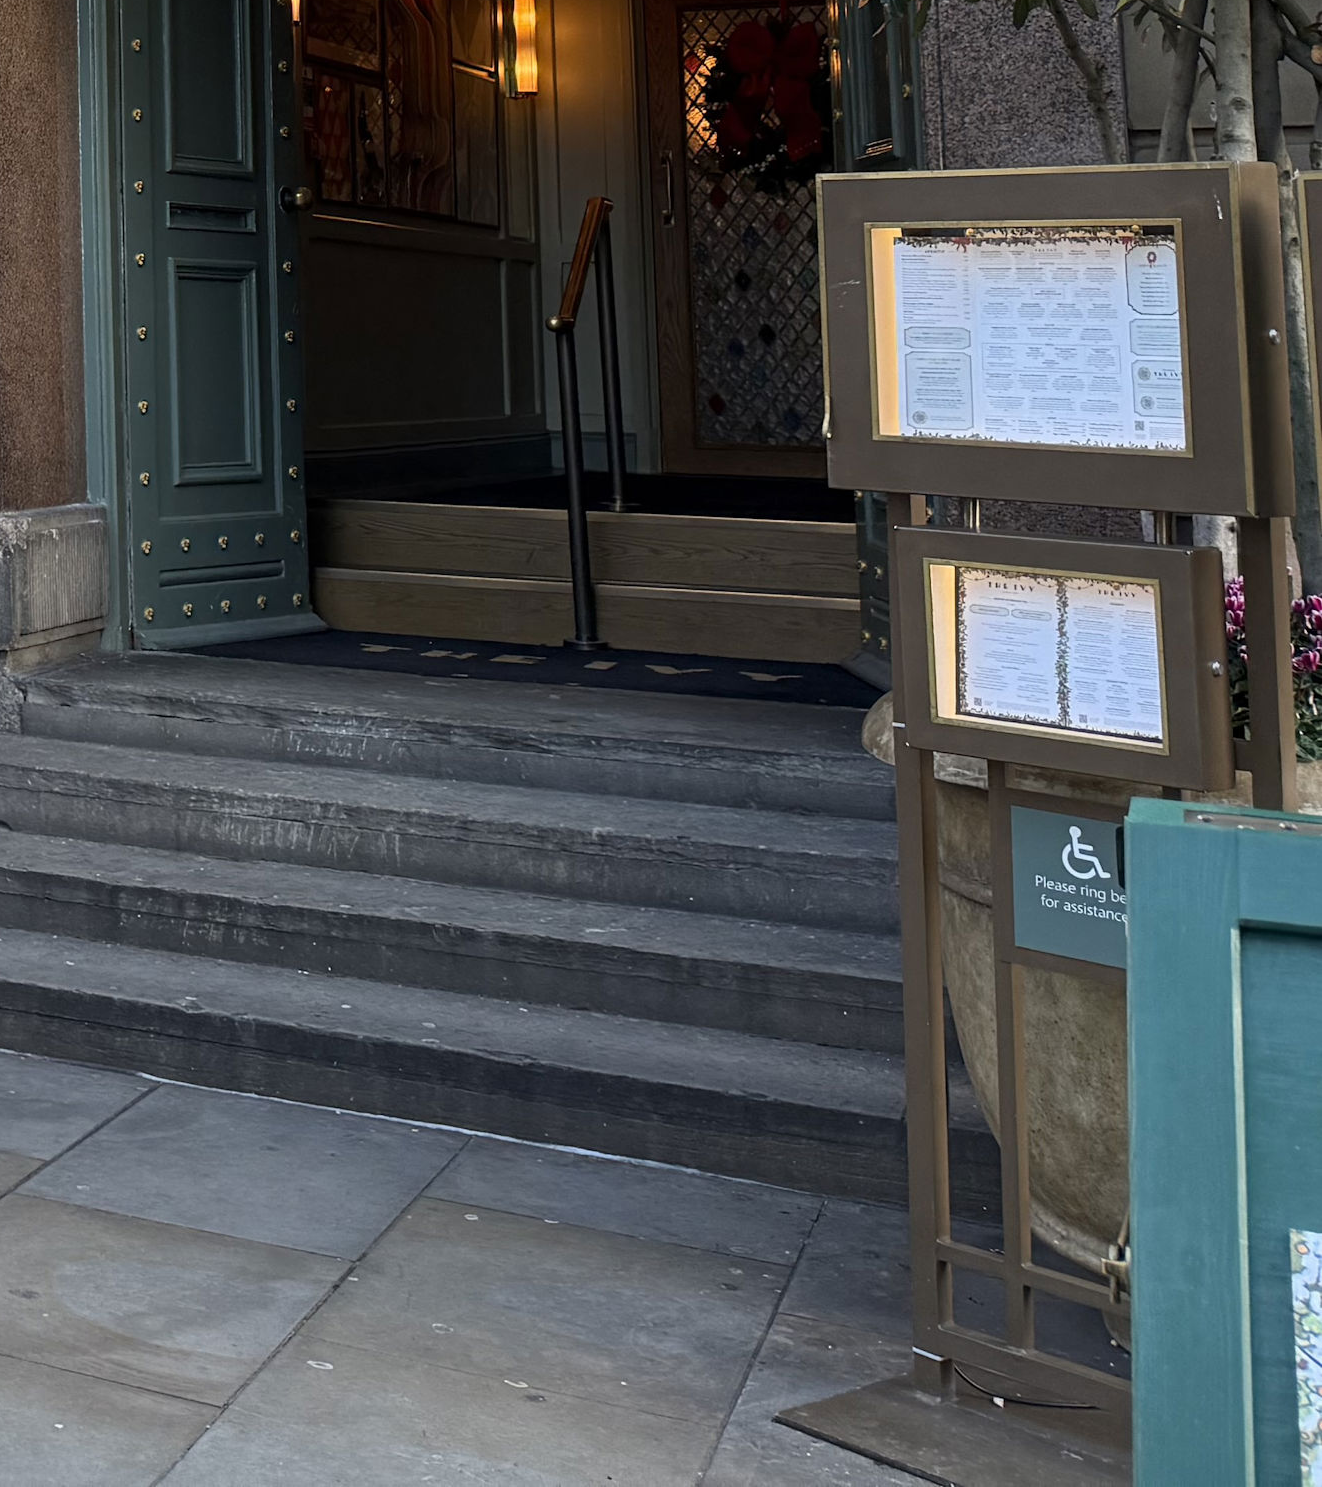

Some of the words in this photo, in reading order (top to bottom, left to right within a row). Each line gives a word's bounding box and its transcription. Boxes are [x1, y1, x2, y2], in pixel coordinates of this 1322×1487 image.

[583, 660, 804, 682] IVY
[1035, 874, 1076, 894] Please
[1080, 885, 1106, 903] ring
[1041, 894, 1059, 908] for
[1063, 901, 1128, 922] assistance
